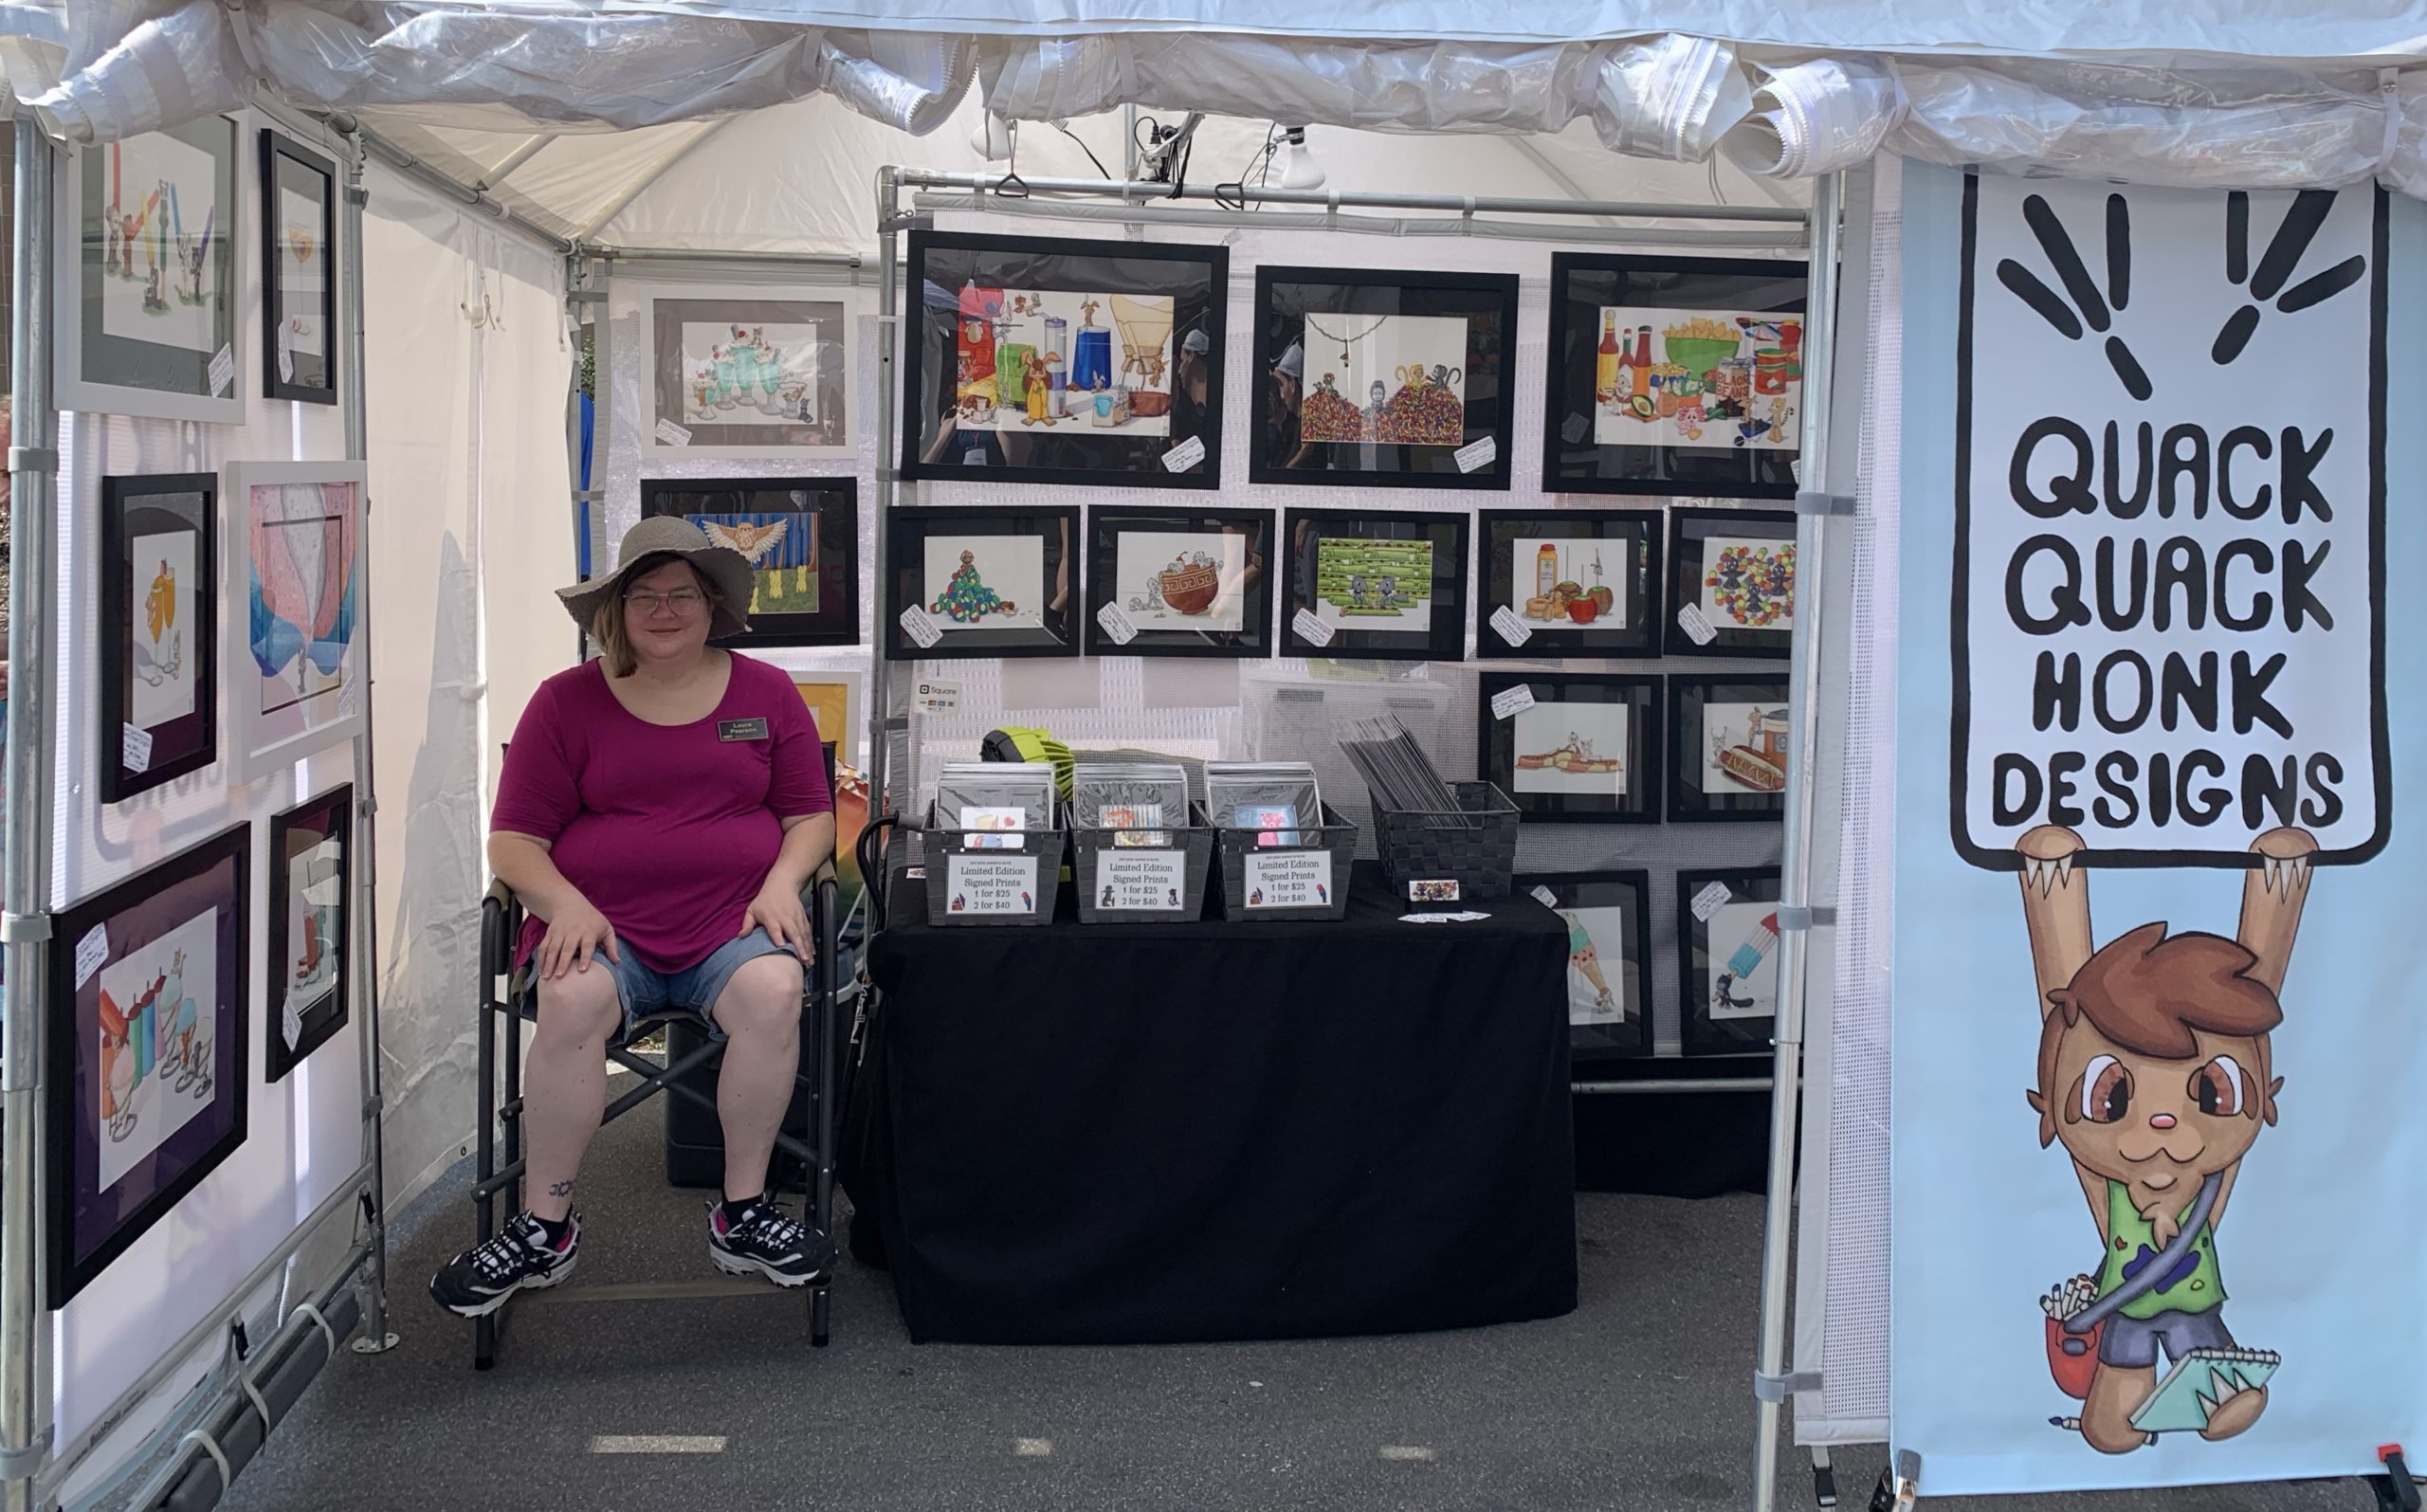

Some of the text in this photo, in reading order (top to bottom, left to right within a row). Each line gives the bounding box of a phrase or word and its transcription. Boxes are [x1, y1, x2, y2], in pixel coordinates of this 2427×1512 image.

[1717, 384, 1749, 398] BEANS
[2009, 416, 2333, 524] QUACK
[2004, 533, 2333, 635] QUACK
[931, 686, 957, 695] Square
[2033, 649, 2294, 739] HONK
[1992, 749, 2344, 829] DESIGNS
[1143, 864, 1173, 872] Edition
[1258, 860, 1319, 869] Limited Edition
[960, 866, 1026, 875] Limited Edition
[1113, 875, 1168, 884] Signed Prints
[1261, 872, 1288, 882] Signed
[964, 878, 993, 887] Signed
[995, 889, 1010, 898] $25
